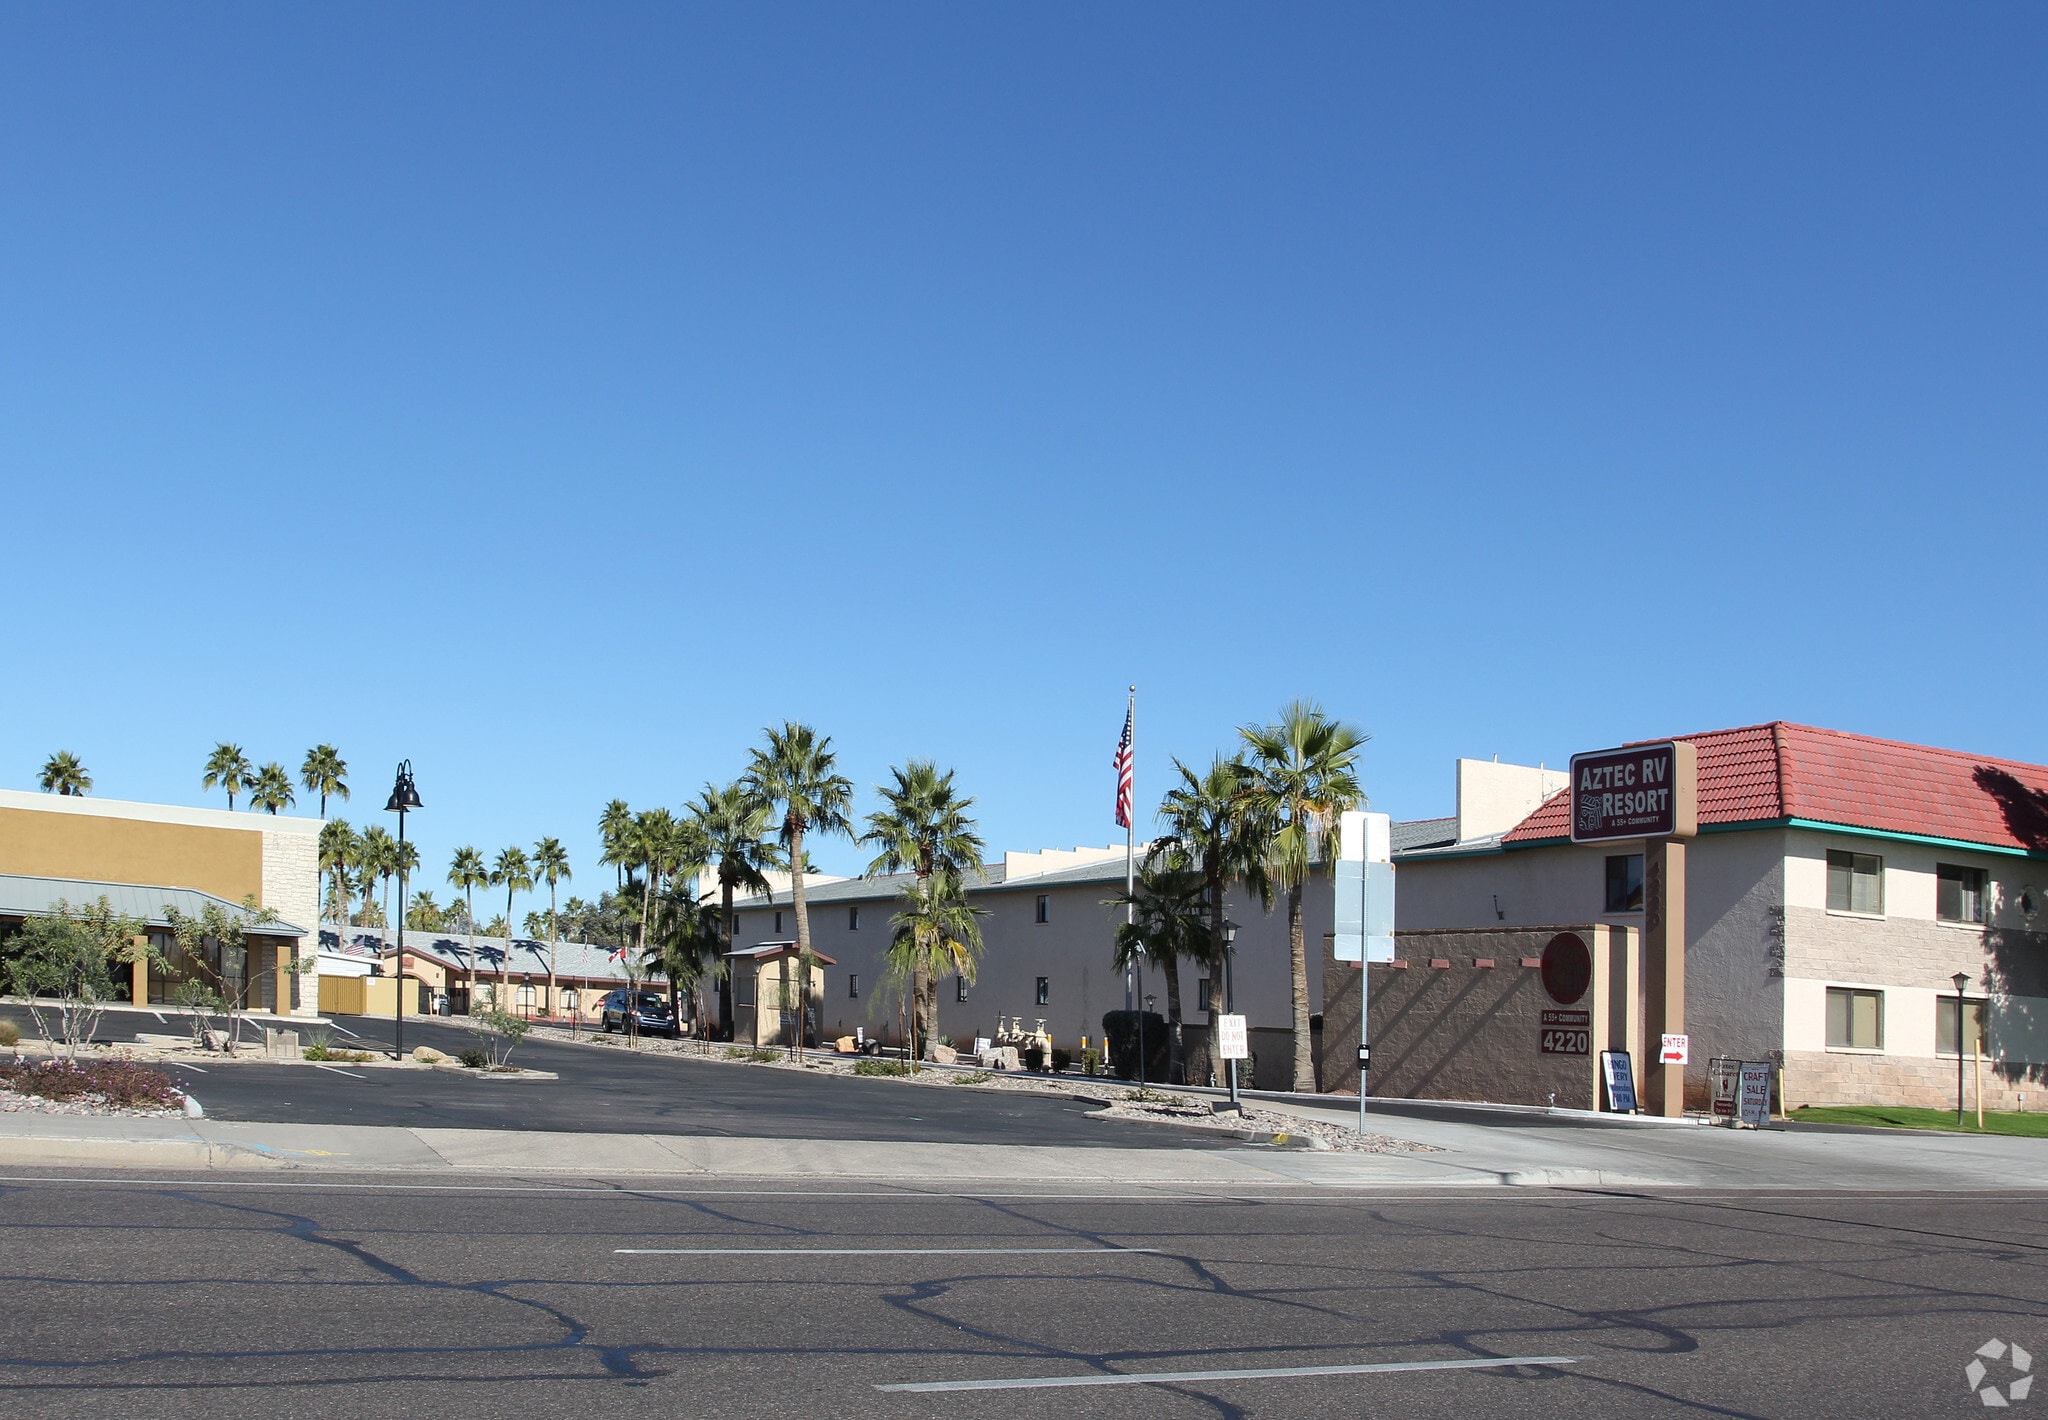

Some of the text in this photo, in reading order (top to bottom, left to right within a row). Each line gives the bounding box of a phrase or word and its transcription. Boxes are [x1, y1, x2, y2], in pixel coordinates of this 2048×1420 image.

[1580, 757, 1667, 791] AZTEC RV
[1602, 788, 1669, 817] RESORT
[1611, 819, 1616, 827] A
[1628, 816, 1660, 825] COMMUNITY
[1223, 1018, 1241, 1028] EXIT
[1543, 1013, 1588, 1023] A 55+ COMMUNITY
[1221, 1031, 1244, 1041] DO NOT
[1543, 1031, 1588, 1053] 4220
[1663, 1037, 1686, 1048] ENTER
[1223, 1044, 1245, 1055] ENTER
[1607, 1059, 1627, 1070] BINGO
[1609, 1072, 1628, 1081] EVERY
[1743, 1072, 1768, 1082] CRAFT
[1746, 1085, 1765, 1095] SALE
